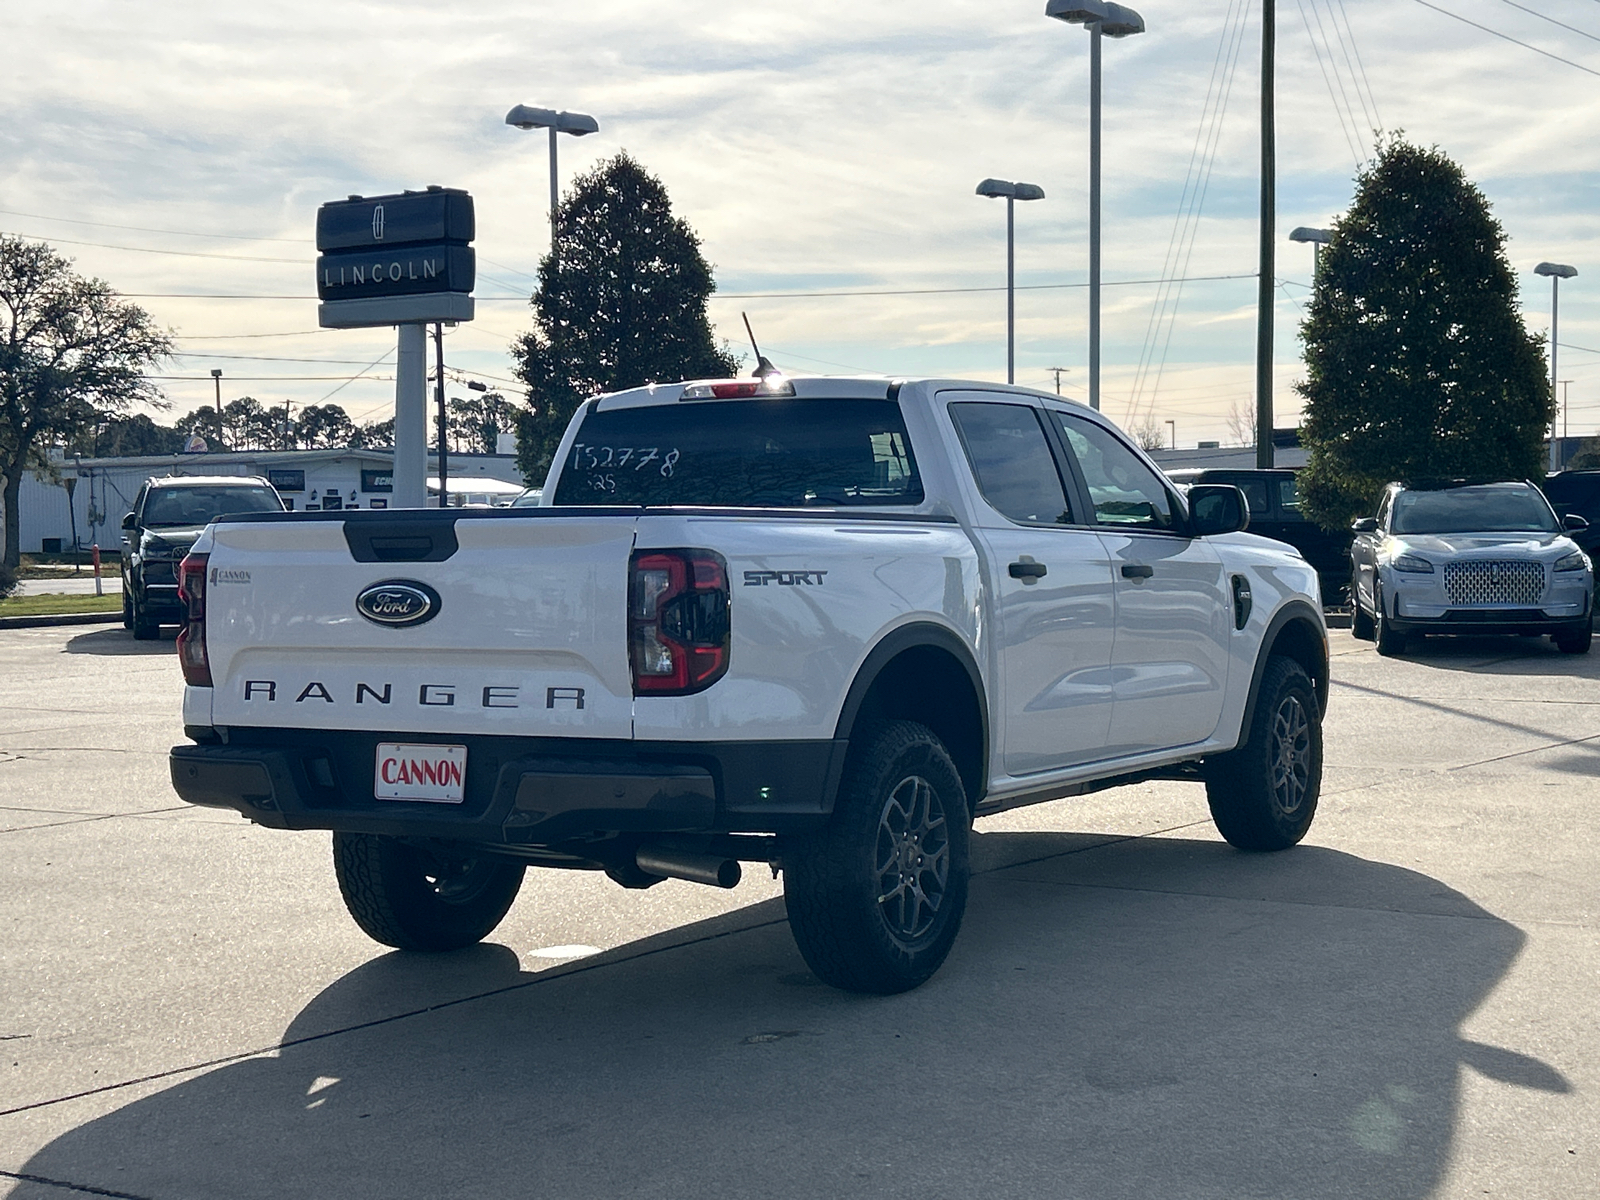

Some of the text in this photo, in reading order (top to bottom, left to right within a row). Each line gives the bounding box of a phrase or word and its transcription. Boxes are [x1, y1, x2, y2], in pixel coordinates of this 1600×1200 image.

[325, 259, 436, 287] LINCOLN
[218, 570, 251, 580] CANNON
[743, 570, 828, 586] SPORT
[372, 592, 411, 613] Ford
[244, 680, 585, 710] RANGER
[381, 757, 462, 787] CANNON
